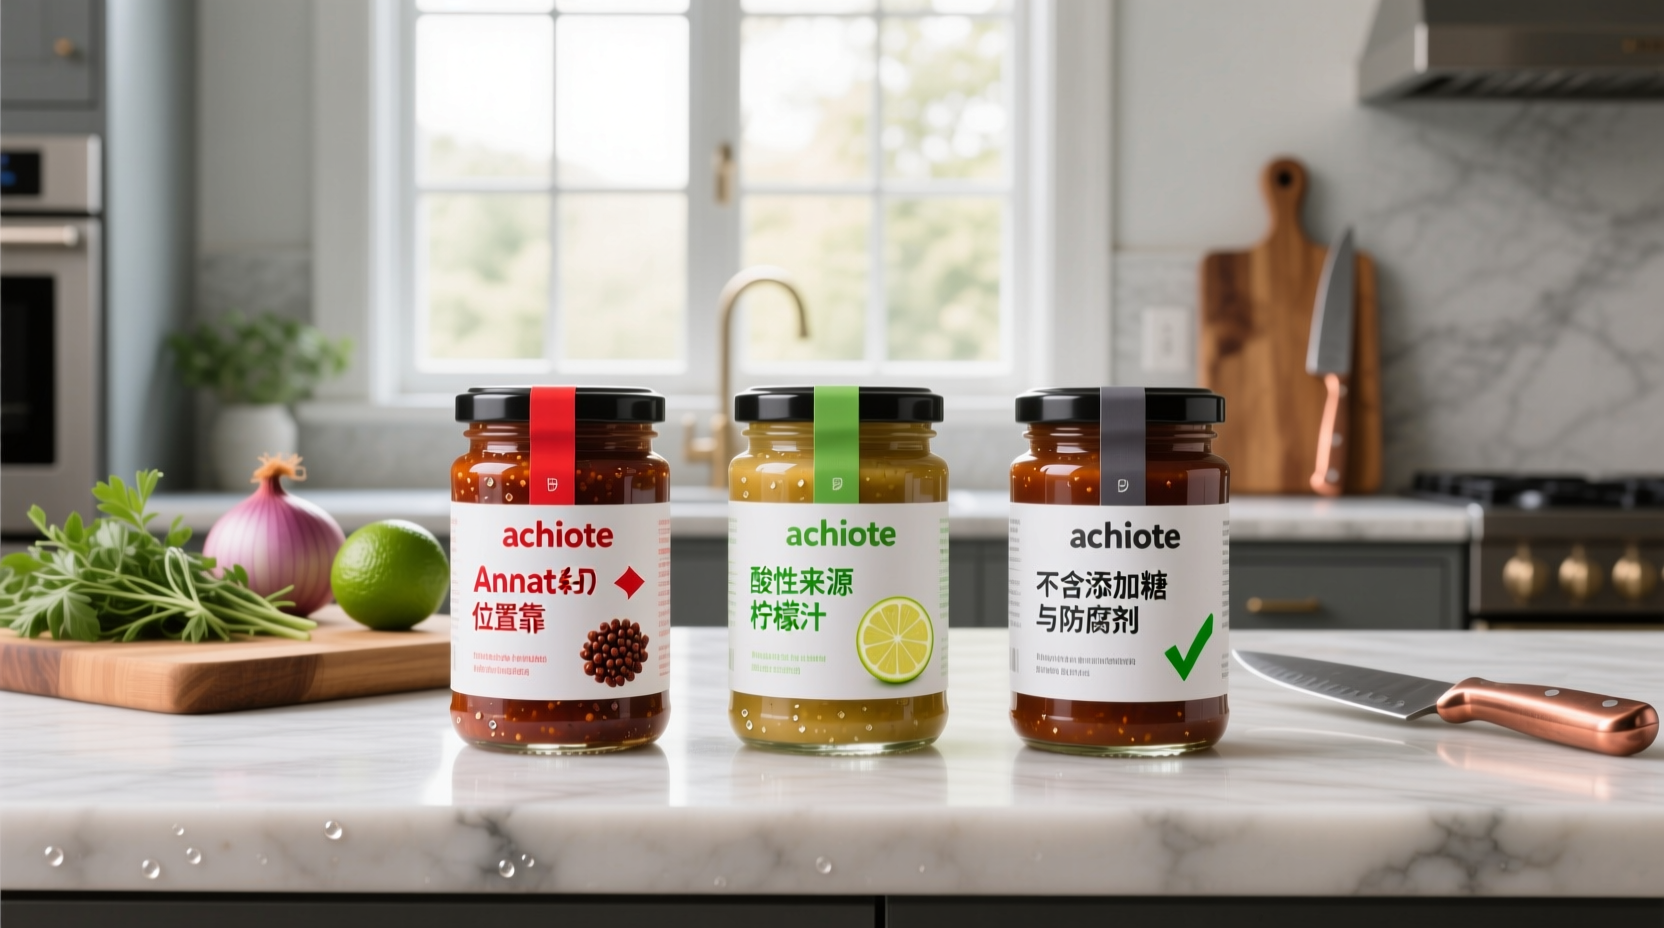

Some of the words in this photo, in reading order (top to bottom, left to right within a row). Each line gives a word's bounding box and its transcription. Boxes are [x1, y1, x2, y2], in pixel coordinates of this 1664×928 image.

[502, 520, 614, 548] achiote
[786, 518, 897, 547] achiote
[1070, 520, 1181, 549] achiote
[750, 565, 854, 597] 酸性来源
[1036, 569, 1168, 601] 不含添加糖
[472, 601, 546, 634] 位置靠
[750, 599, 827, 632] 柠檬汁
[1036, 603, 1139, 635] 与防腐剂
